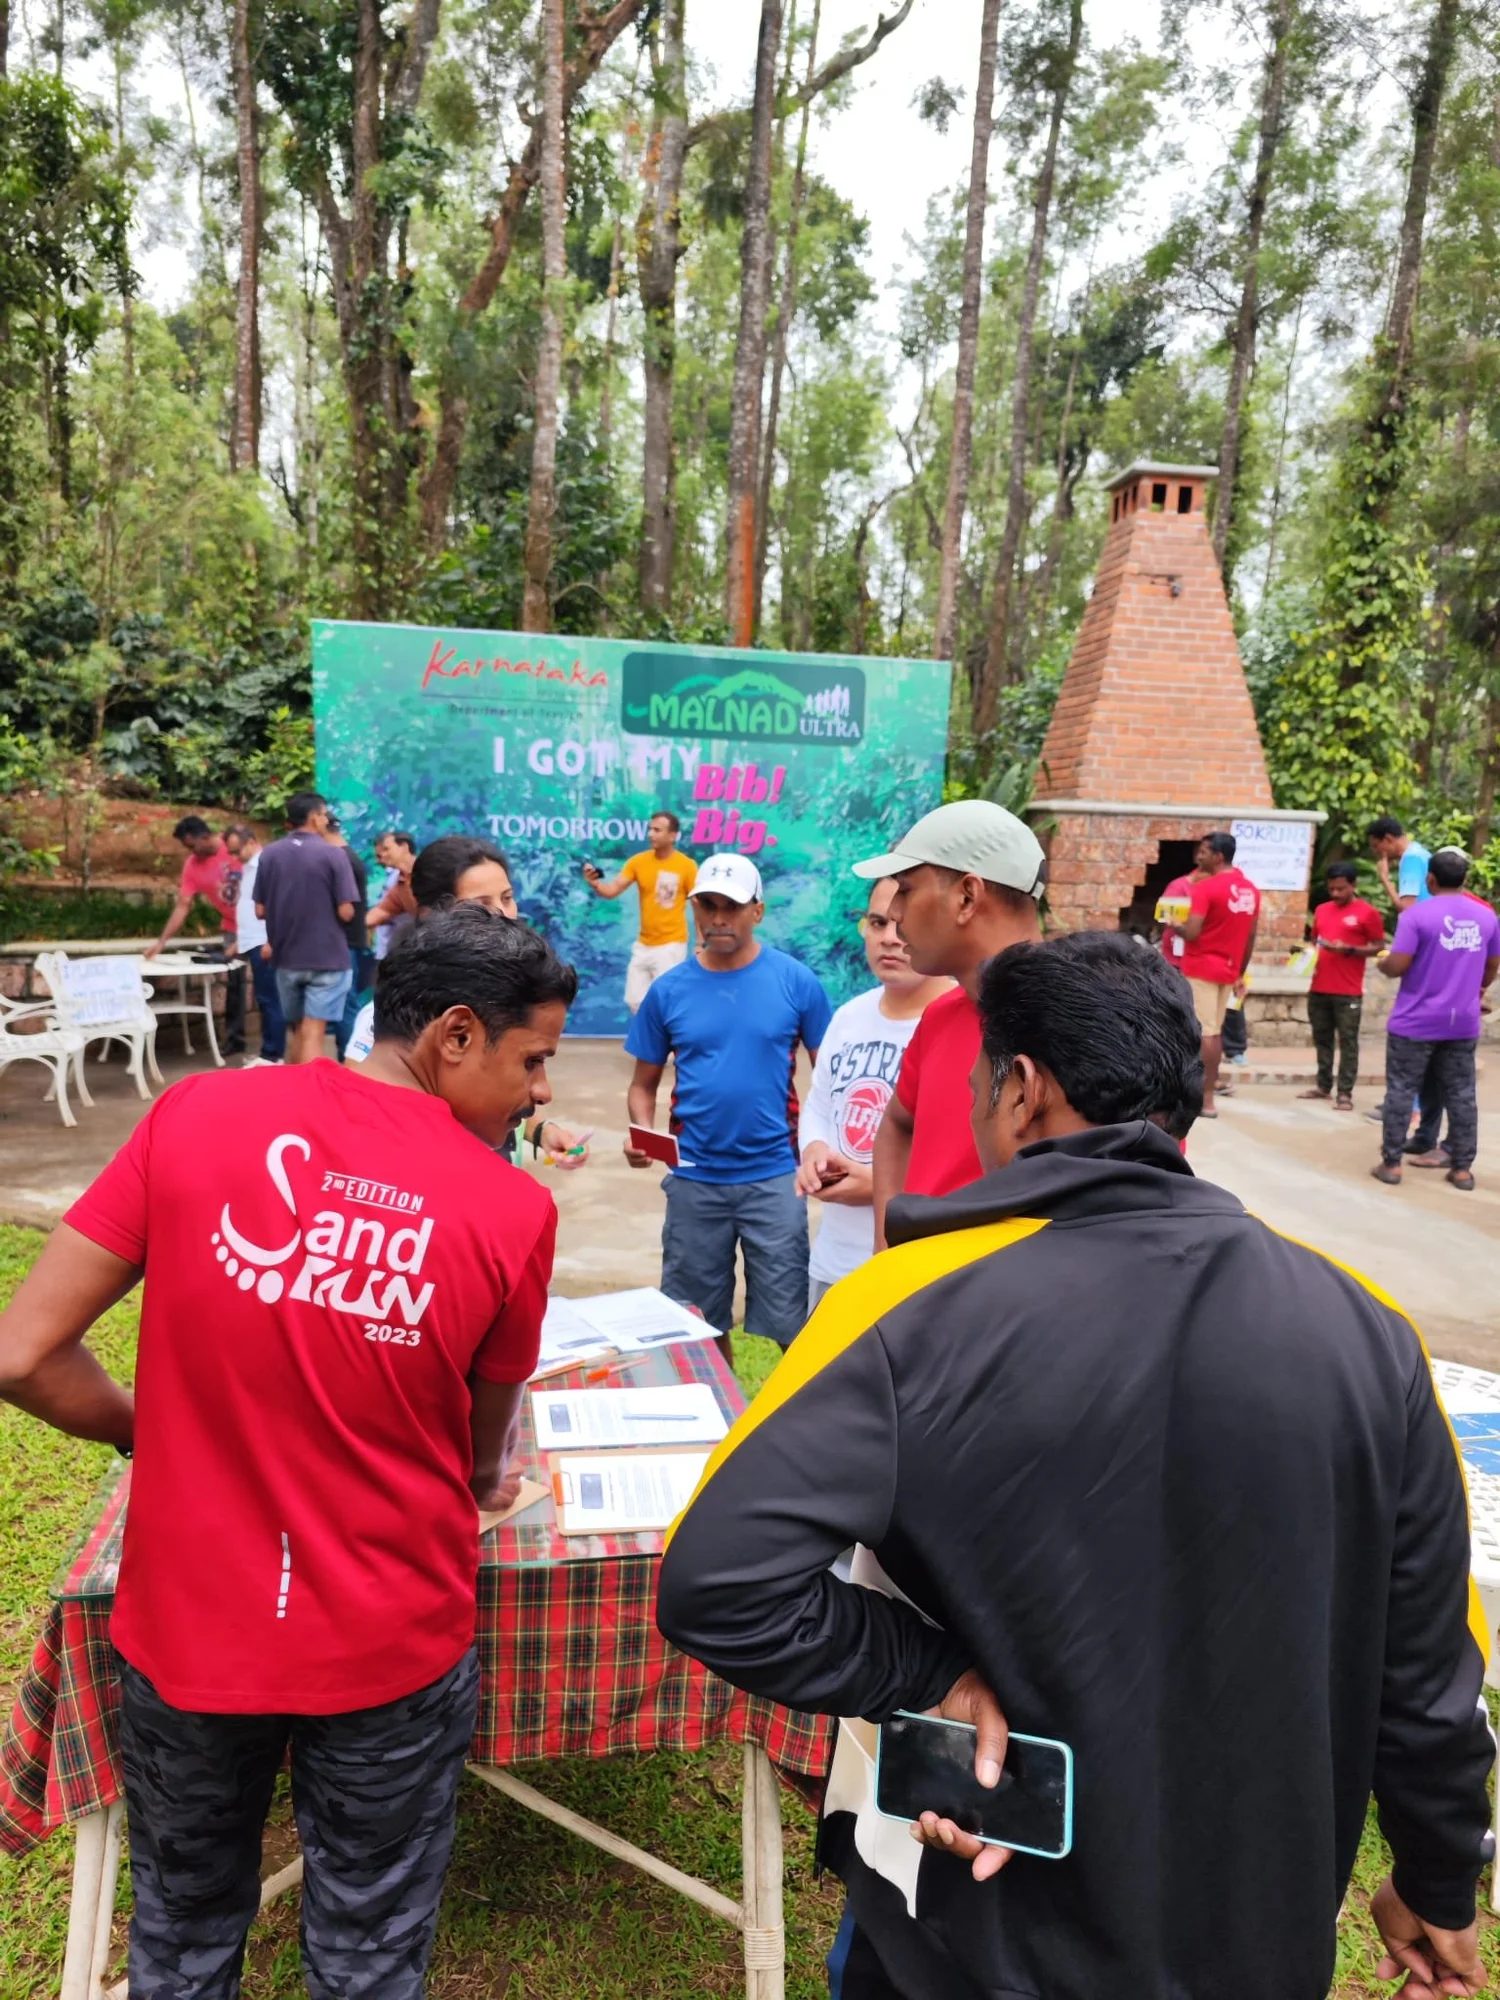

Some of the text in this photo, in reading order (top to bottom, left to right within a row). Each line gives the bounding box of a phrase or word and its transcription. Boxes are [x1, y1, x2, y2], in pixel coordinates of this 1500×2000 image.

[421, 639, 608, 688] Karnataka
[649, 693, 798, 736] MALNAD
[800, 717, 861, 738] ULTRA
[493, 737, 786, 804] I GOT MY Bib!
[691, 808, 778, 854] Big.
[345, 1179, 424, 1212] EDITION
[363, 1323, 421, 1347] 2023
